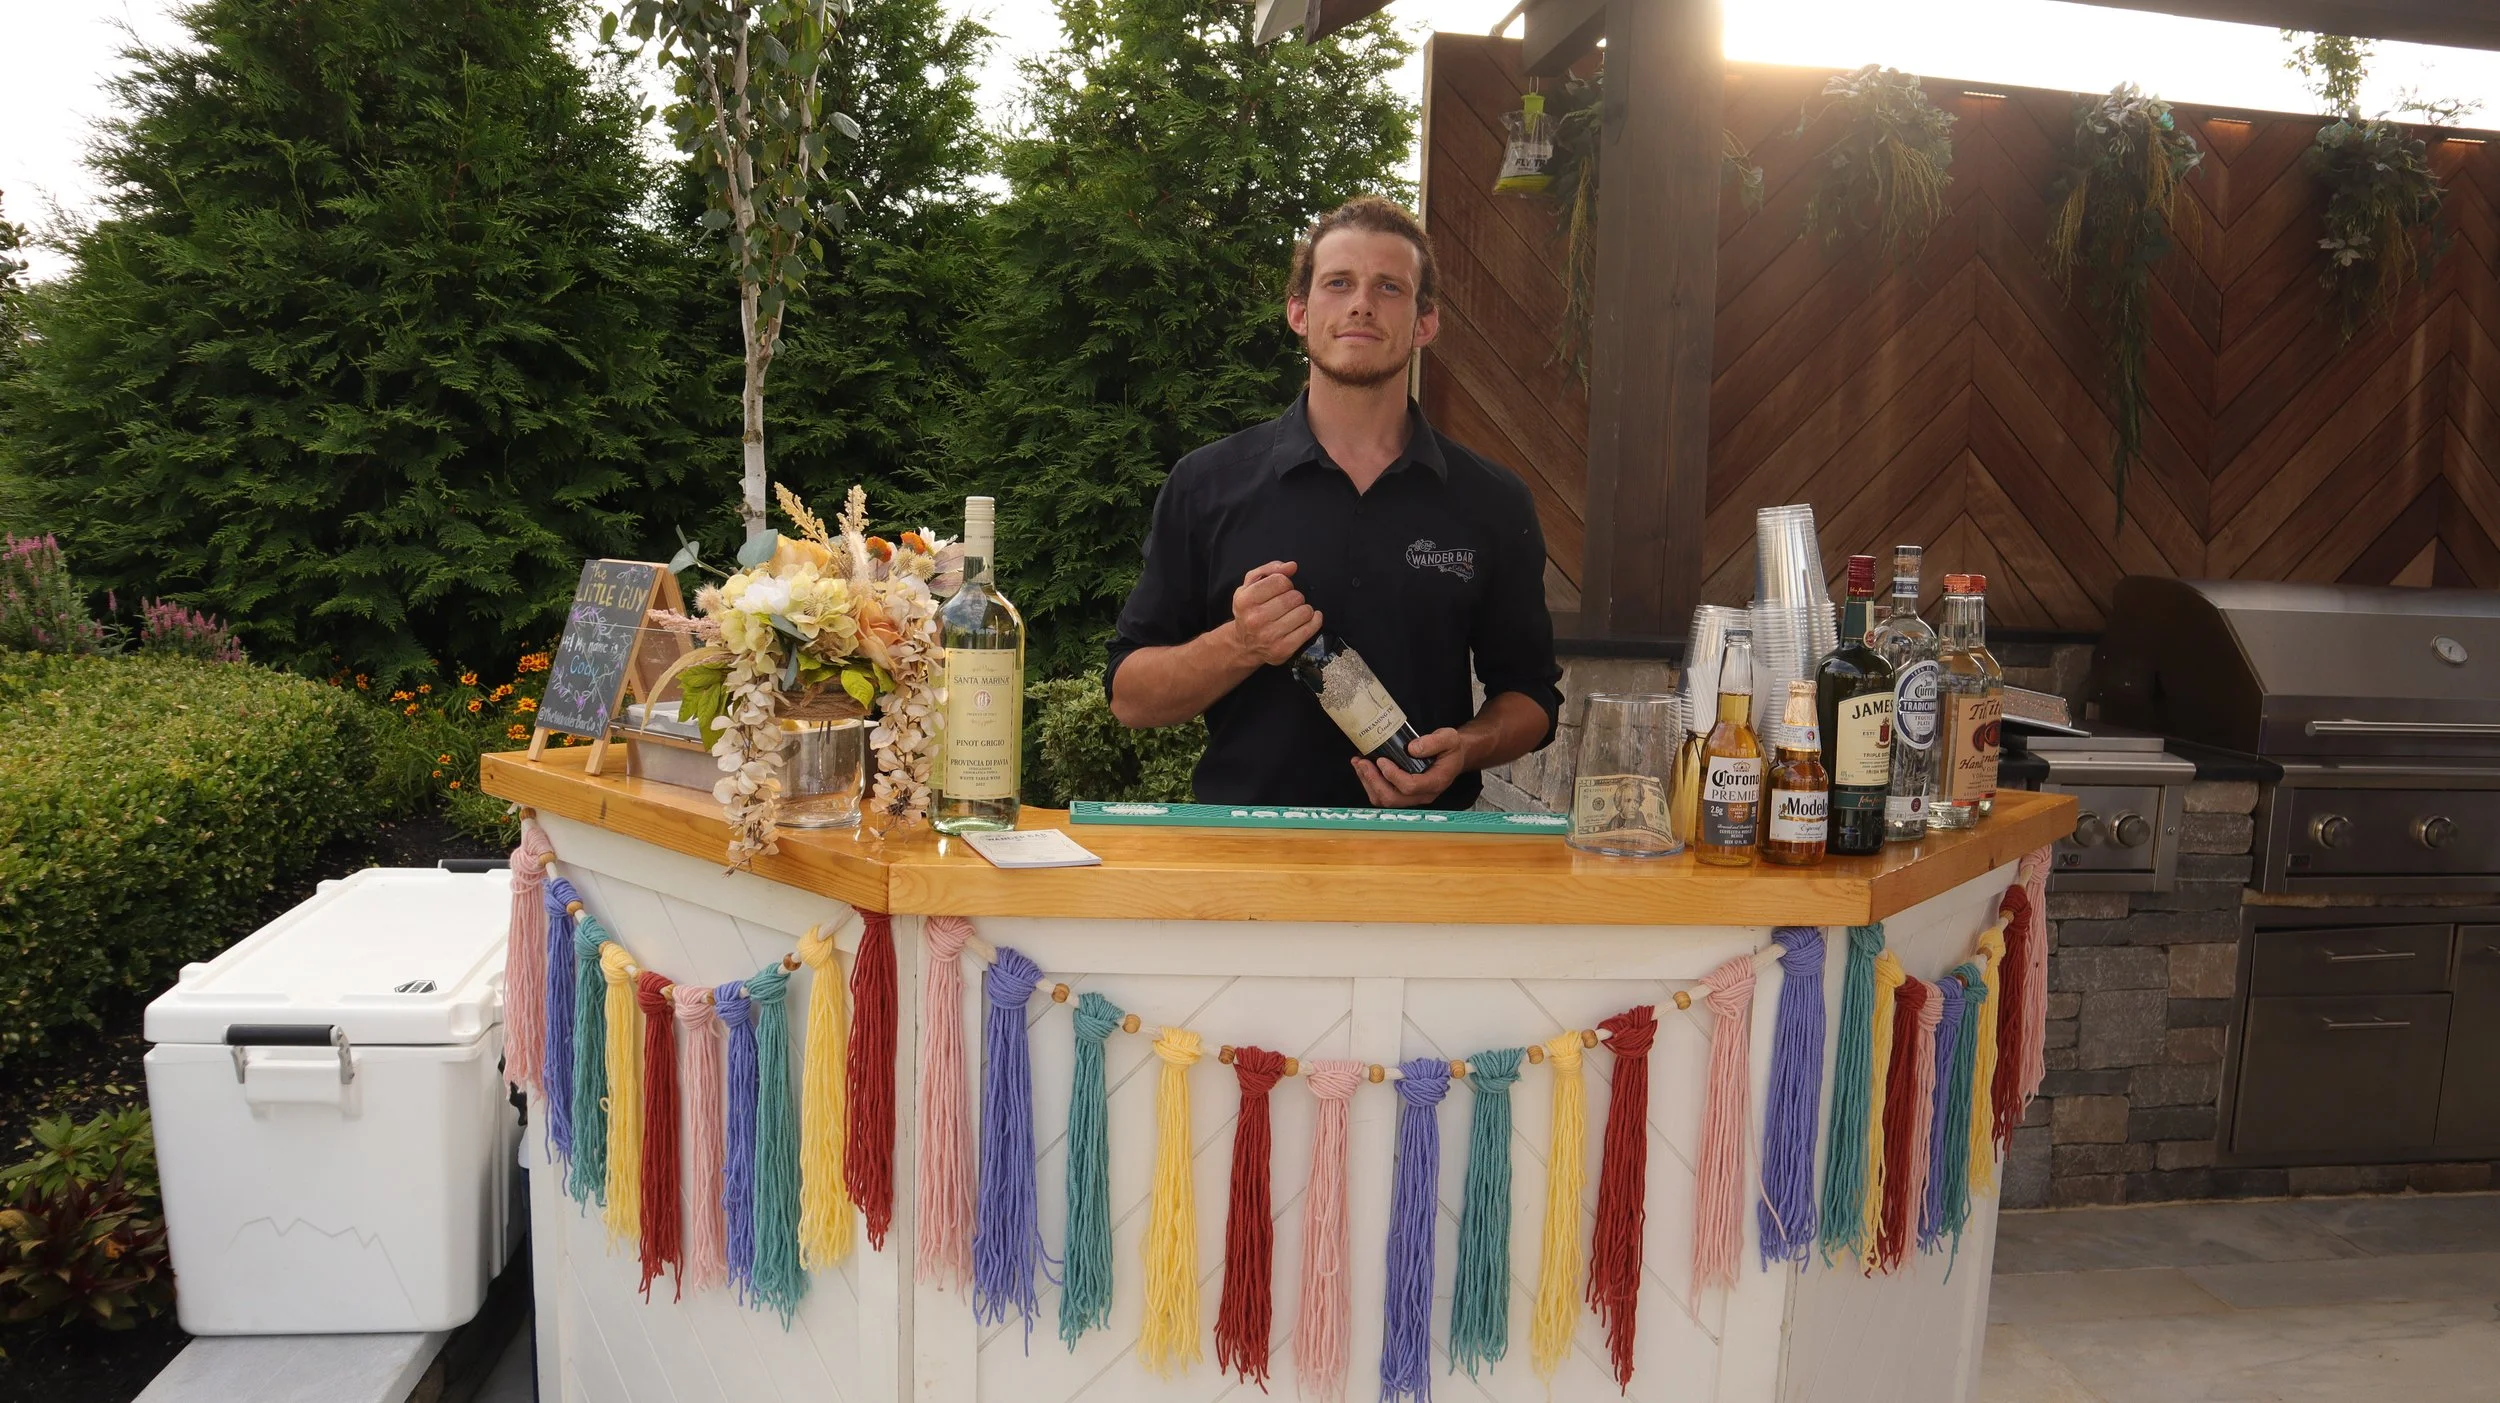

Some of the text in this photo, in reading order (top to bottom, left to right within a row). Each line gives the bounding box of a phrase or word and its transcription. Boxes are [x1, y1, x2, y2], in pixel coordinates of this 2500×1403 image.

[1412, 551, 1474, 565] WANDER BAR
[576, 583, 649, 612] LITTLE GUY
[570, 655, 599, 681] Cody
[953, 676, 1010, 685] SANTA MARINA
[1361, 711, 1388, 736] DREAMING
[956, 739, 1005, 747] PINOT GRIGIO
[950, 758, 1009, 767] PROVINCIA DI PAVIA
